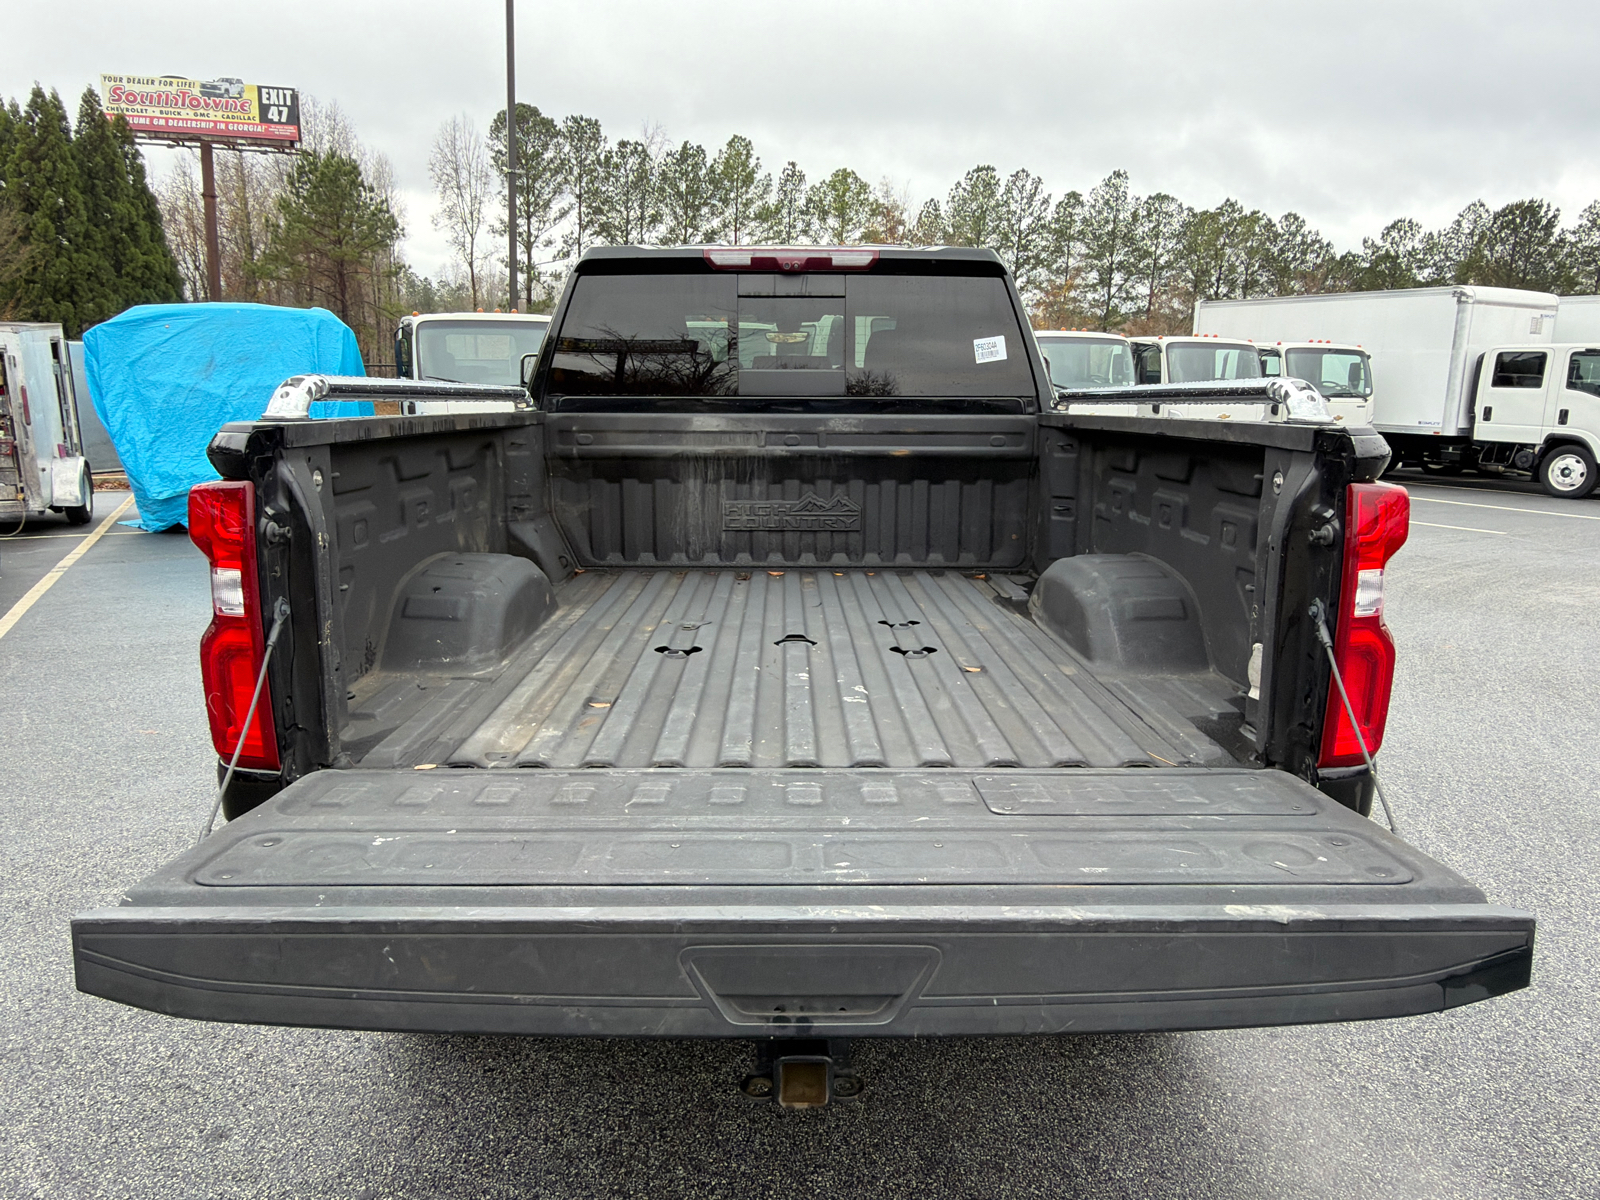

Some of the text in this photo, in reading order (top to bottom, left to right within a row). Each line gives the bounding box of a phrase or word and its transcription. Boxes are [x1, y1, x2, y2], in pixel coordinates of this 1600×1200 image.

[103, 75, 196, 89] YOUR DEALER FOR LIFE!
[261, 87, 293, 106] EXIT
[105, 105, 149, 114] CHEVROLET
[221, 113, 257, 122] CADILLAC
[267, 105, 289, 123] 47
[126, 116, 150, 125] LUME
[153, 117, 166, 126] GM
[168, 118, 215, 129] DEALERSHIP
[216, 122, 226, 130] IN
[228, 122, 265, 133] GEORGIA!
[724, 504, 791, 516] HIGH
[724, 516, 860, 529] COUNTRY
